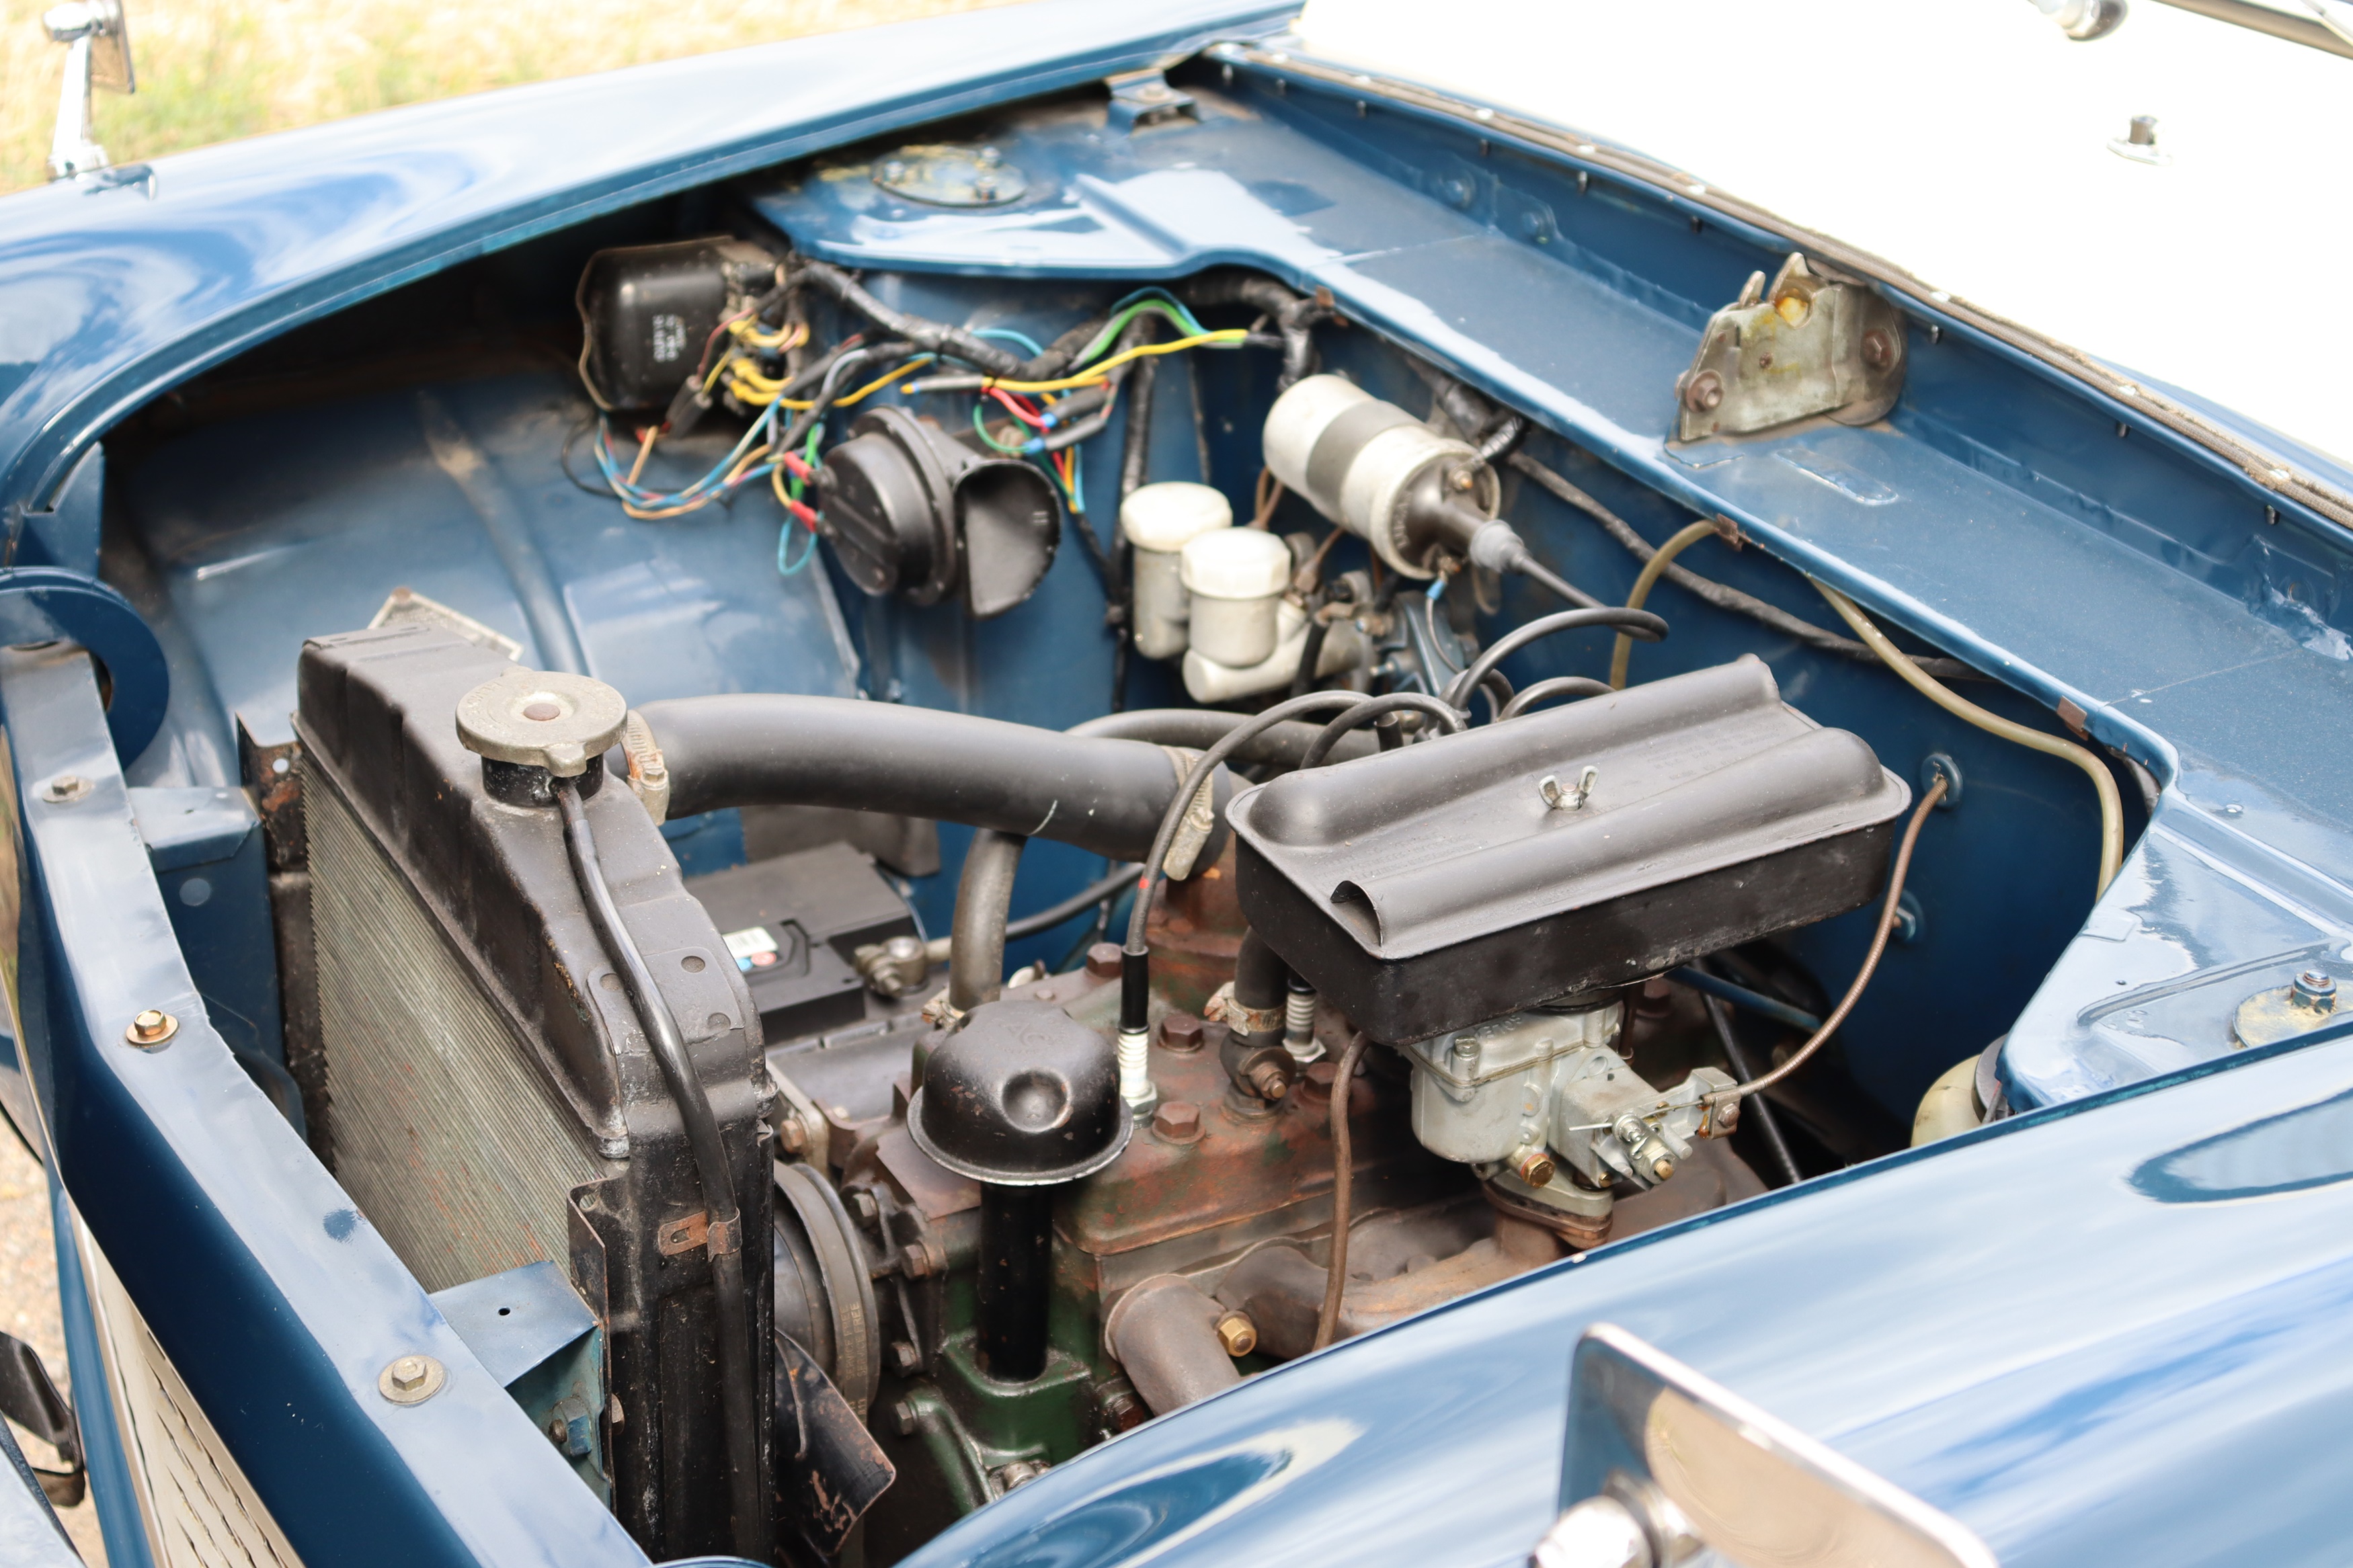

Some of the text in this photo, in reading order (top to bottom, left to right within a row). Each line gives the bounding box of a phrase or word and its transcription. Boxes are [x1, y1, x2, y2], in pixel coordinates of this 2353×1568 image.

[1474, 1014, 1523, 1040] SOLEX
[850, 1302, 864, 1333] FREE
[839, 1304, 856, 1380] SERVICE FREE
[855, 1333, 867, 1377] SERVICE
